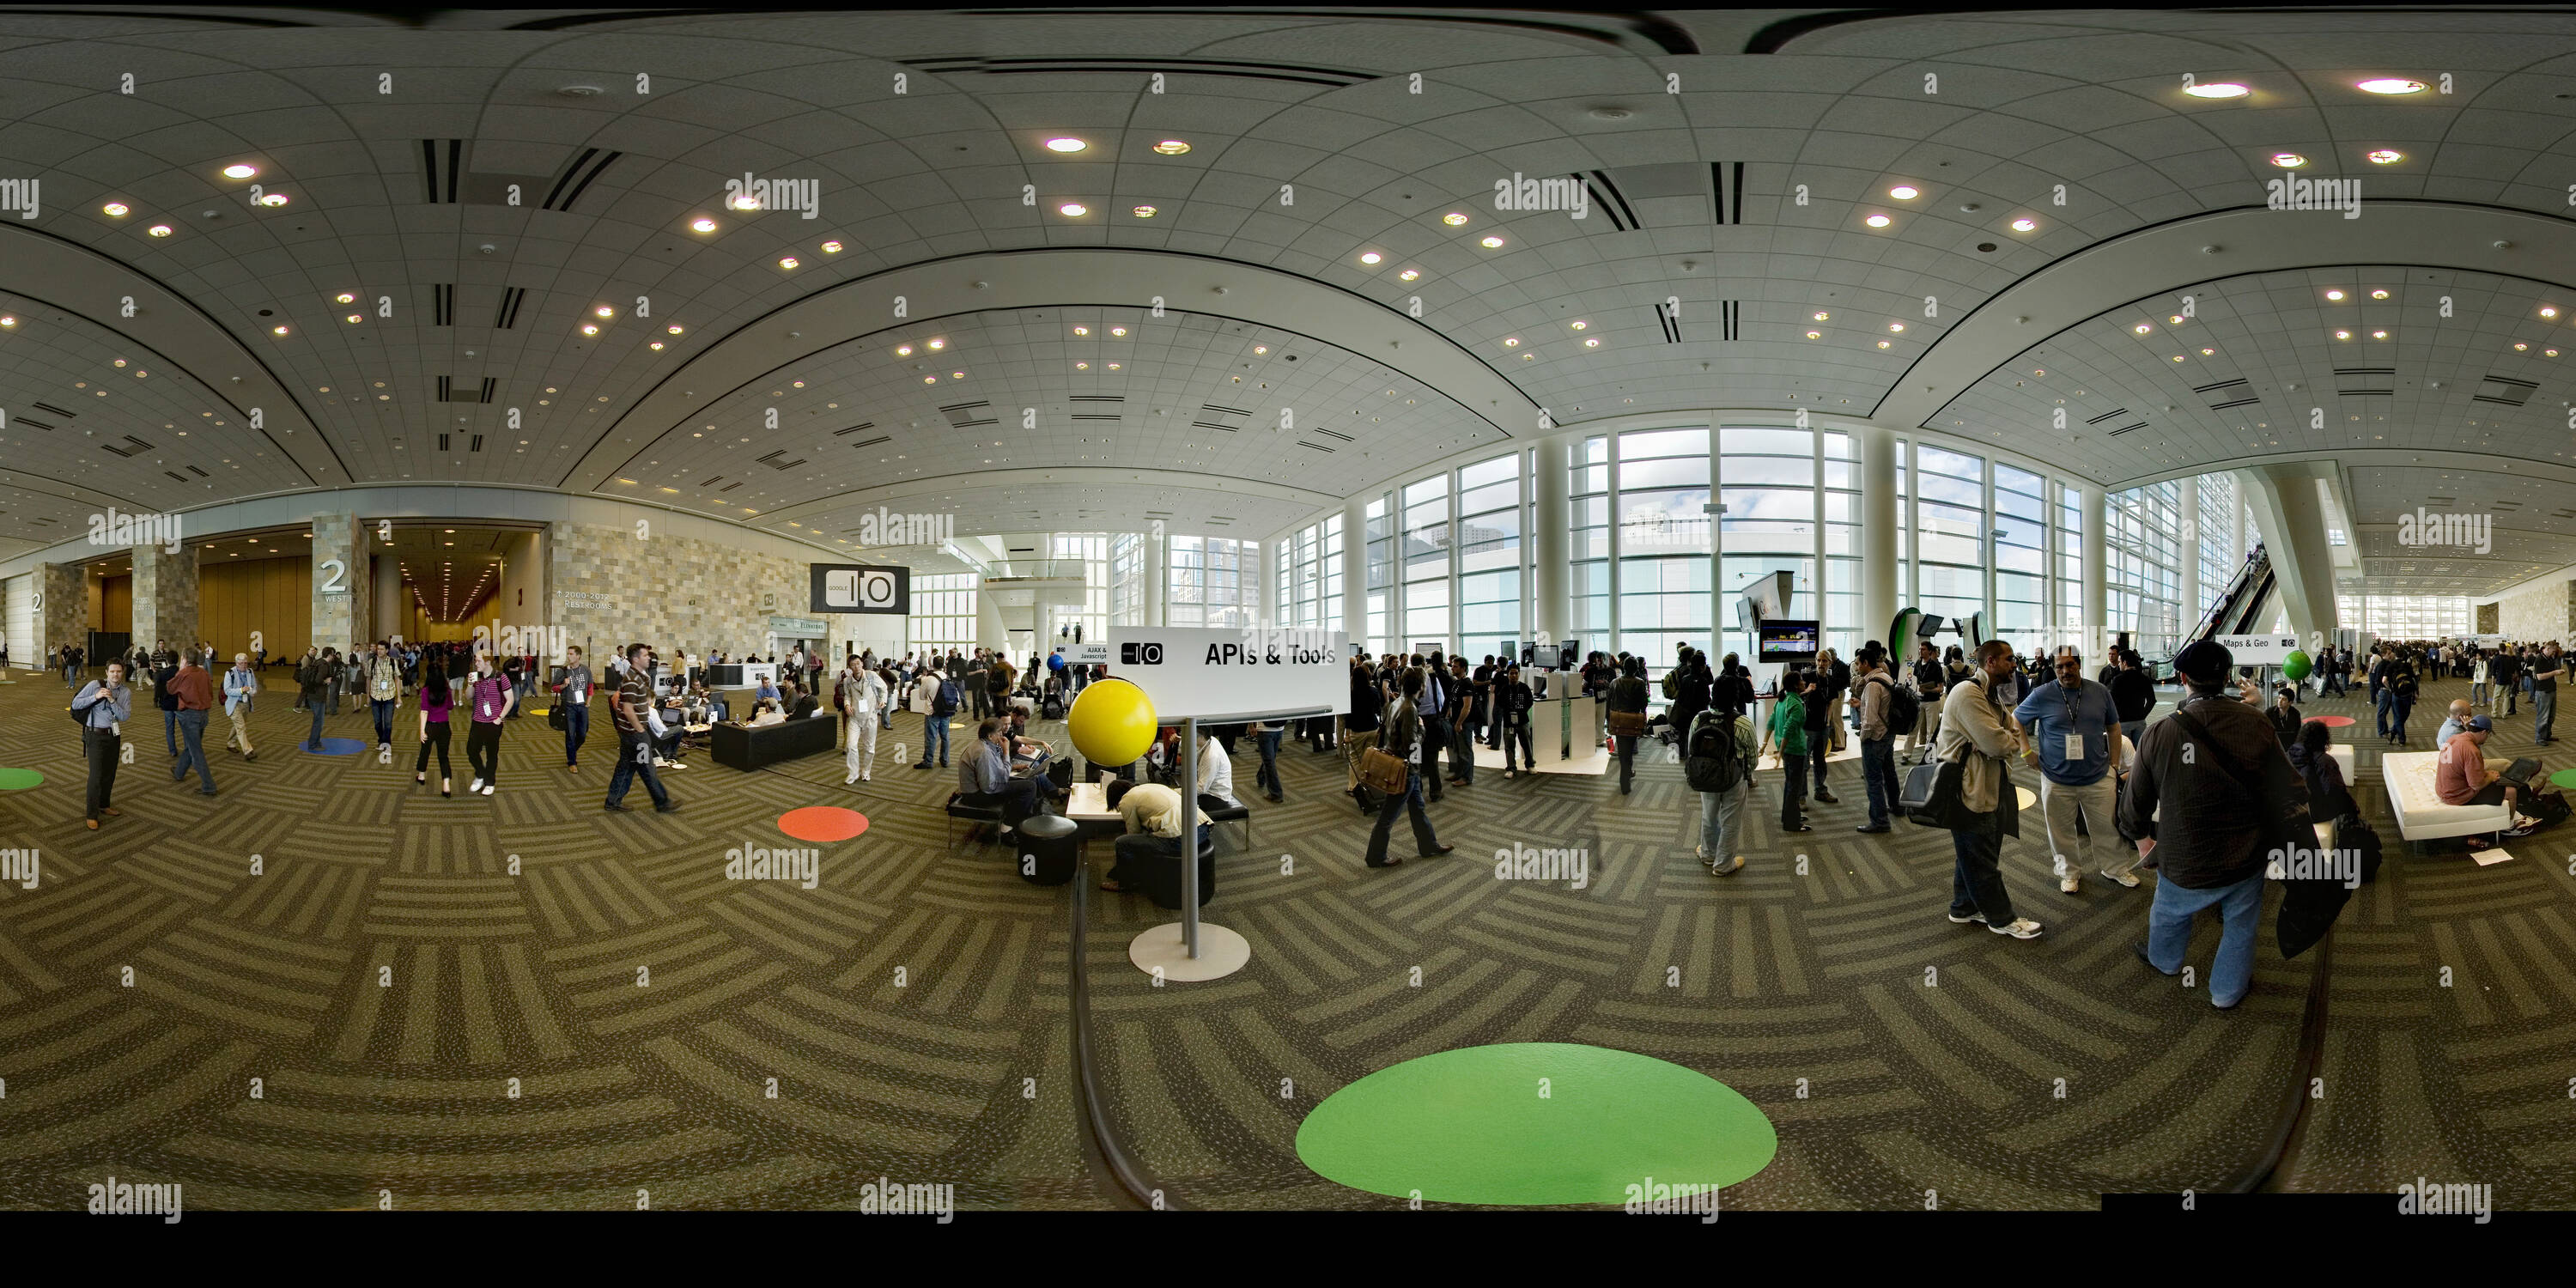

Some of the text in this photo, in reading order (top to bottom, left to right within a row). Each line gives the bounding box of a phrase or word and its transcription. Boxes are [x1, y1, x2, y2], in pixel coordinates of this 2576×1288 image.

[321, 559, 346, 592] 2
[33, 593, 41, 611] 2
[564, 600, 612, 610] RESTROOMS
[2224, 639, 2269, 649] Maps & Geo
[1205, 643, 1336, 665] APIs & Tools
